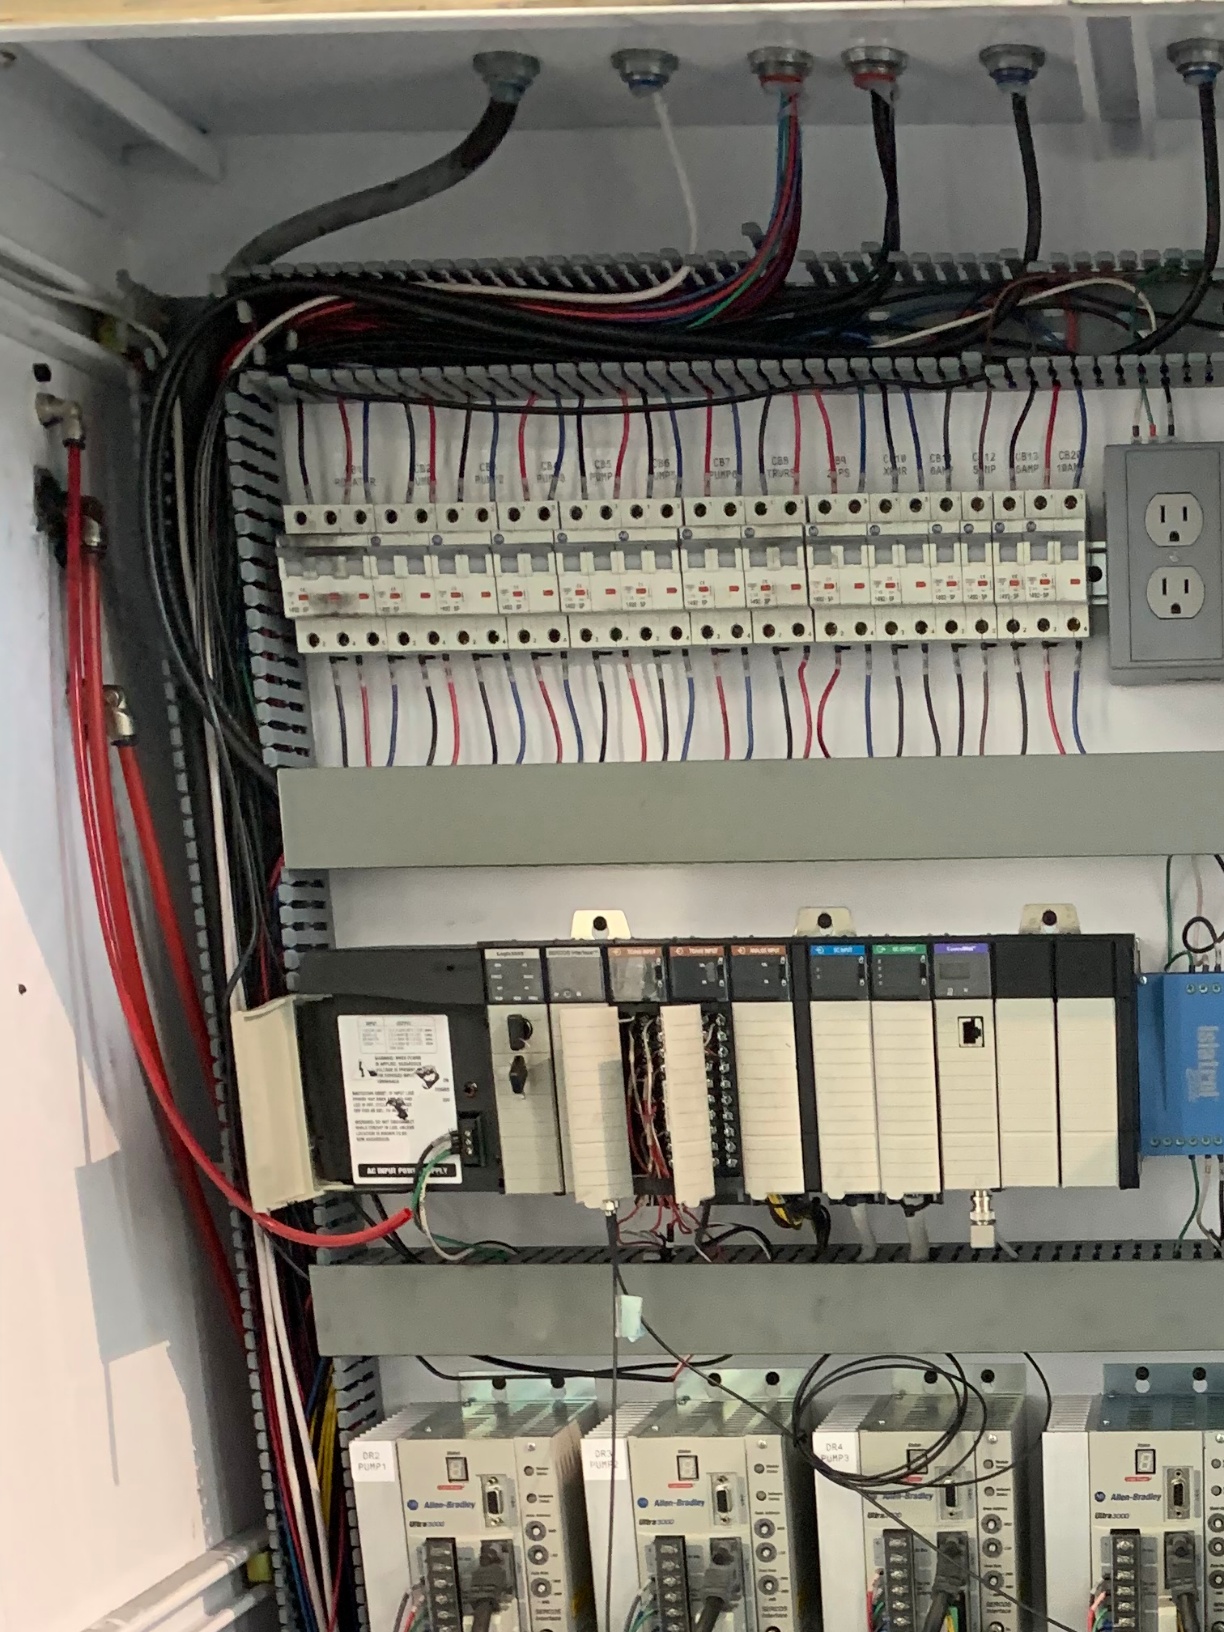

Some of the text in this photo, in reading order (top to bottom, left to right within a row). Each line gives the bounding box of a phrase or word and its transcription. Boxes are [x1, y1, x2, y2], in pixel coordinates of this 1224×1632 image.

[972, 452, 996, 462] C12
[826, 1443, 844, 1452] DR4
[362, 1451, 381, 1460] DR2
[820, 1453, 850, 1463] PUMP3
[358, 1462, 387, 1472] PUMP1
[654, 1498, 706, 1508] Allen-Bradley
[1110, 1493, 1162, 1503] Allen-Bradley
[424, 1500, 476, 1510] Allen-Bradley
